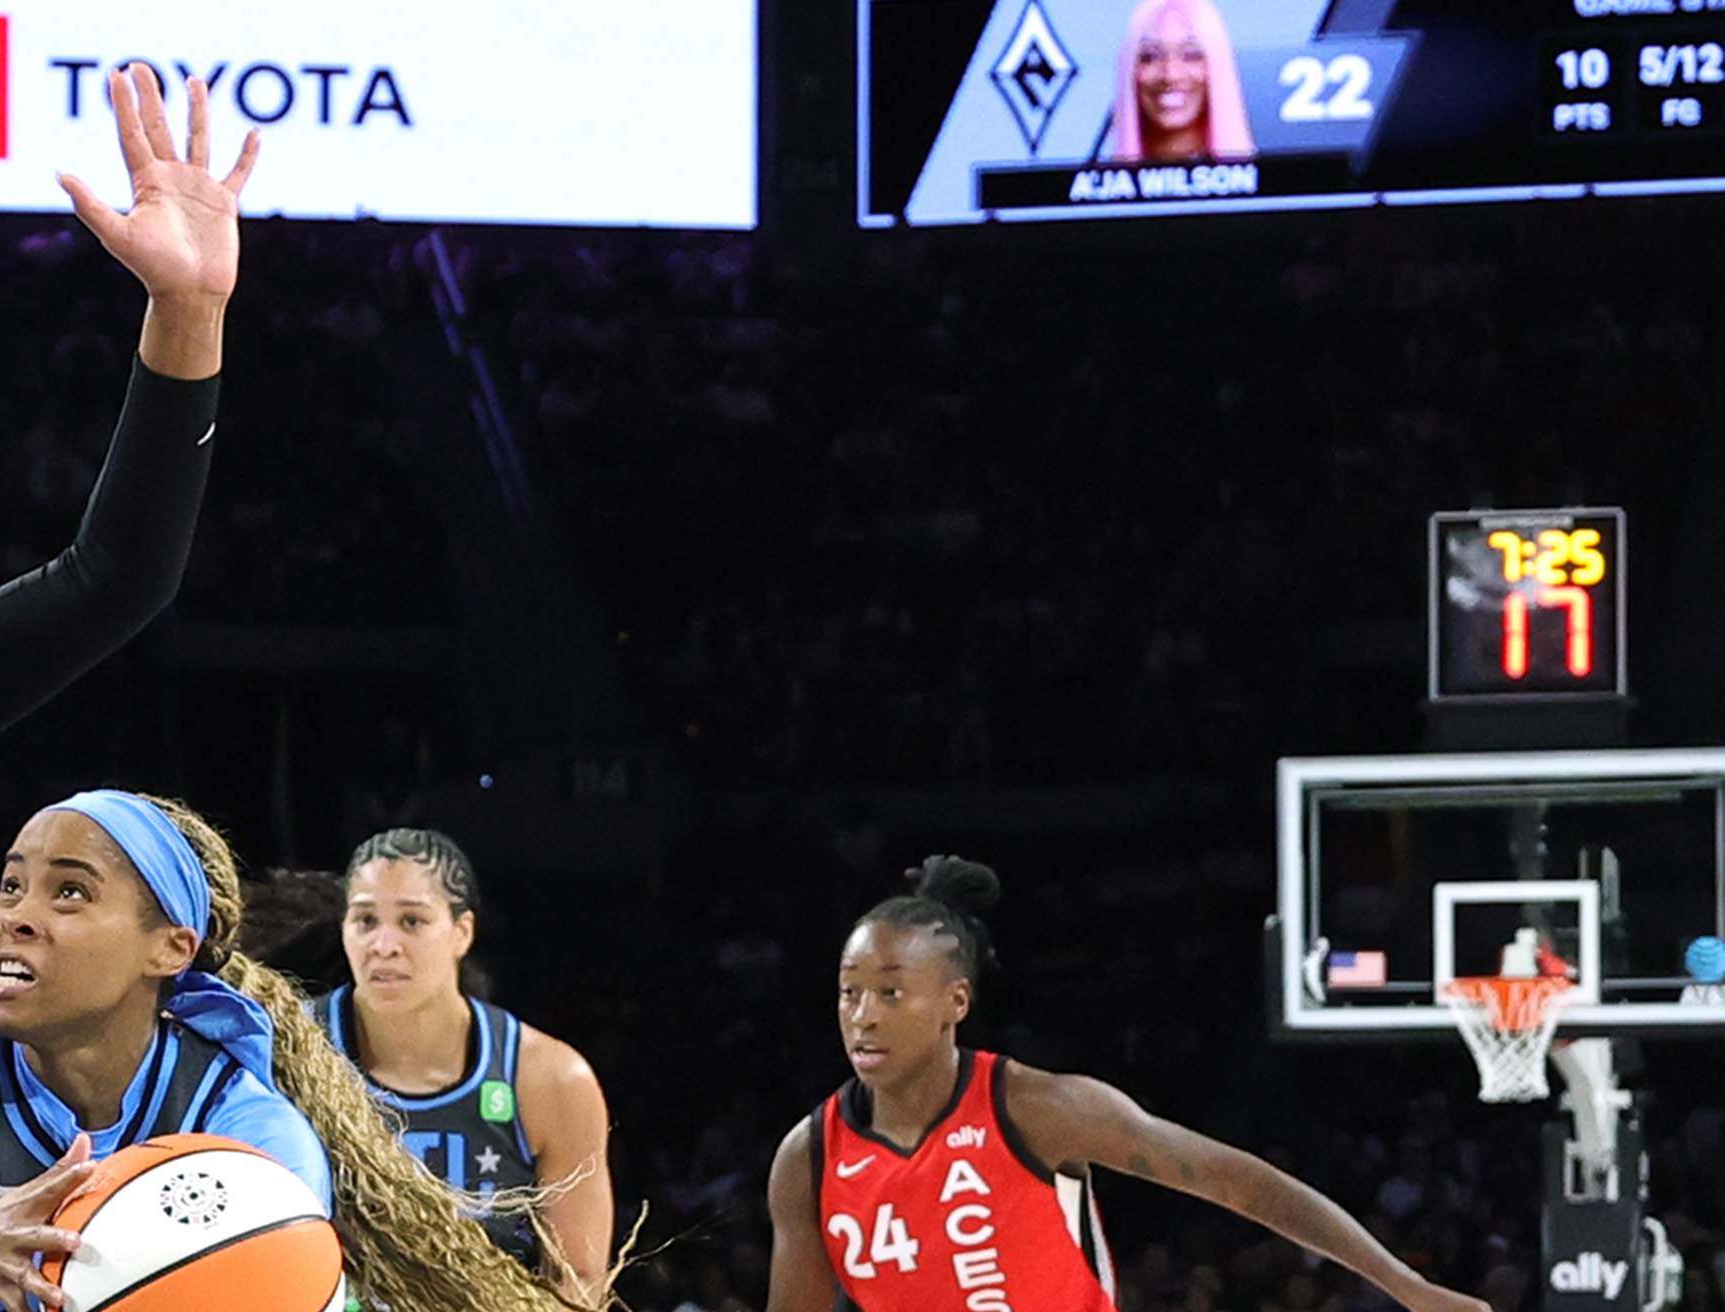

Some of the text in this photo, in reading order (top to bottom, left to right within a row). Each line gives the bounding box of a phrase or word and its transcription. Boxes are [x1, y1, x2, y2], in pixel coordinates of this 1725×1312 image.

[1278, 54, 1375, 121] 22
[1555, 42, 1725, 90] 10 5/12
[1553, 102, 1611, 132] PTS
[1138, 163, 1258, 198] WILSON
[1488, 528, 1605, 586] 7:25
[1502, 585, 1594, 681] 17
[946, 1125, 987, 1149] ally
[827, 1202, 919, 1280] 24
[1550, 1251, 1628, 1300] ally
